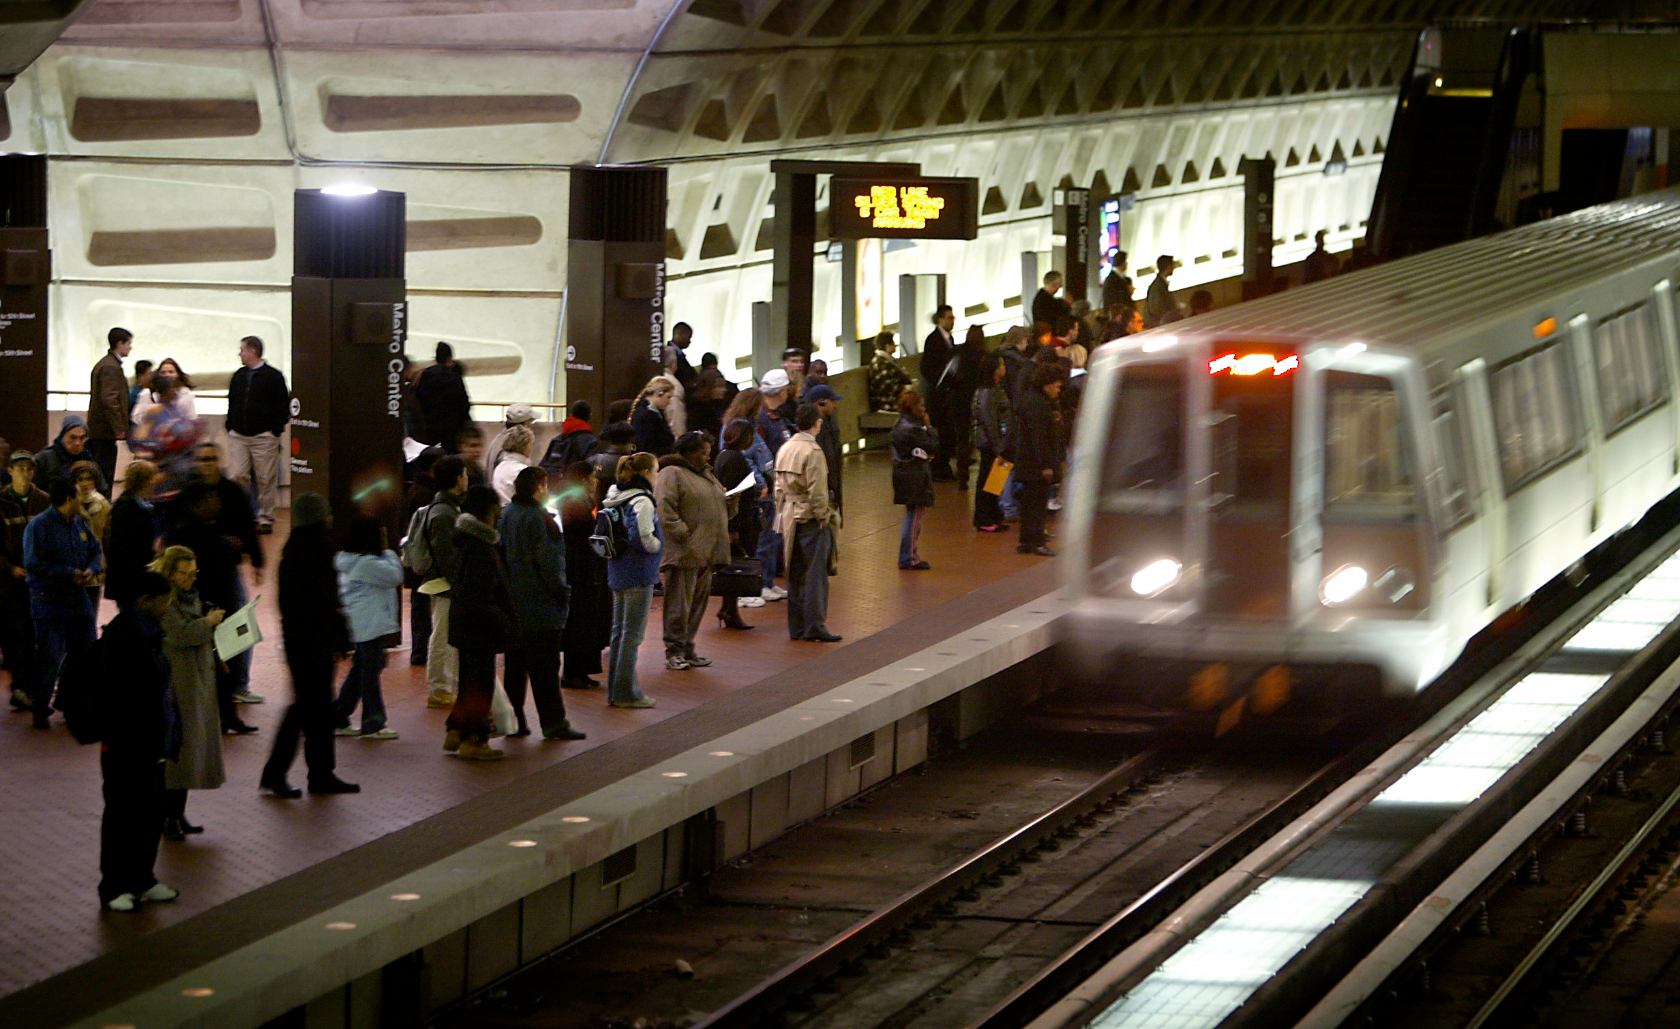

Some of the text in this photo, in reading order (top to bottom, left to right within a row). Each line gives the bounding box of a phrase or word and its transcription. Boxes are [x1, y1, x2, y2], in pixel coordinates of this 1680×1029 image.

[387, 302, 405, 418] Metro Center
[650, 263, 665, 363] Metro Center
